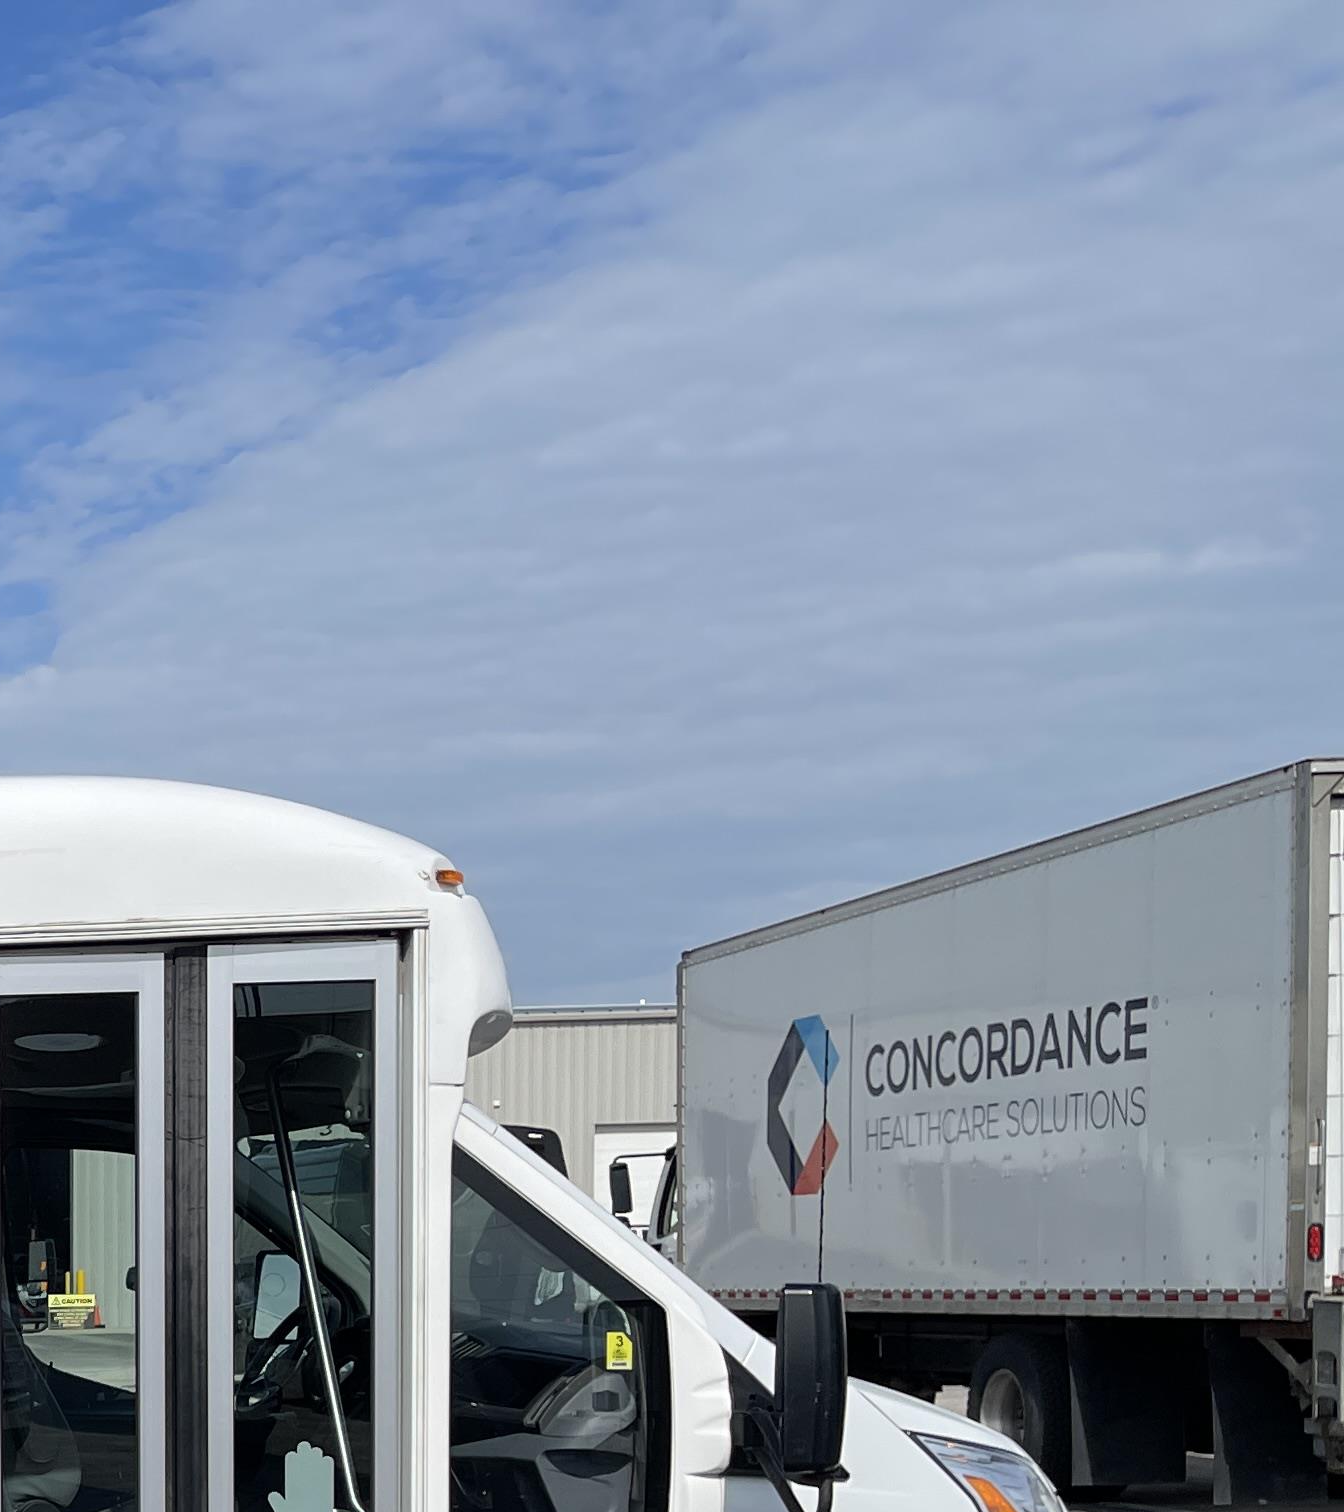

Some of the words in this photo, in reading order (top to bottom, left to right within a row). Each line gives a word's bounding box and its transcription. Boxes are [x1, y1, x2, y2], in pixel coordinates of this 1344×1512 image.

[865, 997, 1148, 1097] CONCORDANCE
[865, 1102, 1000, 1152] HEALTHCARE
[1006, 1085, 1146, 1138] SOLUTIONS
[615, 1335, 624, 1347] 3
